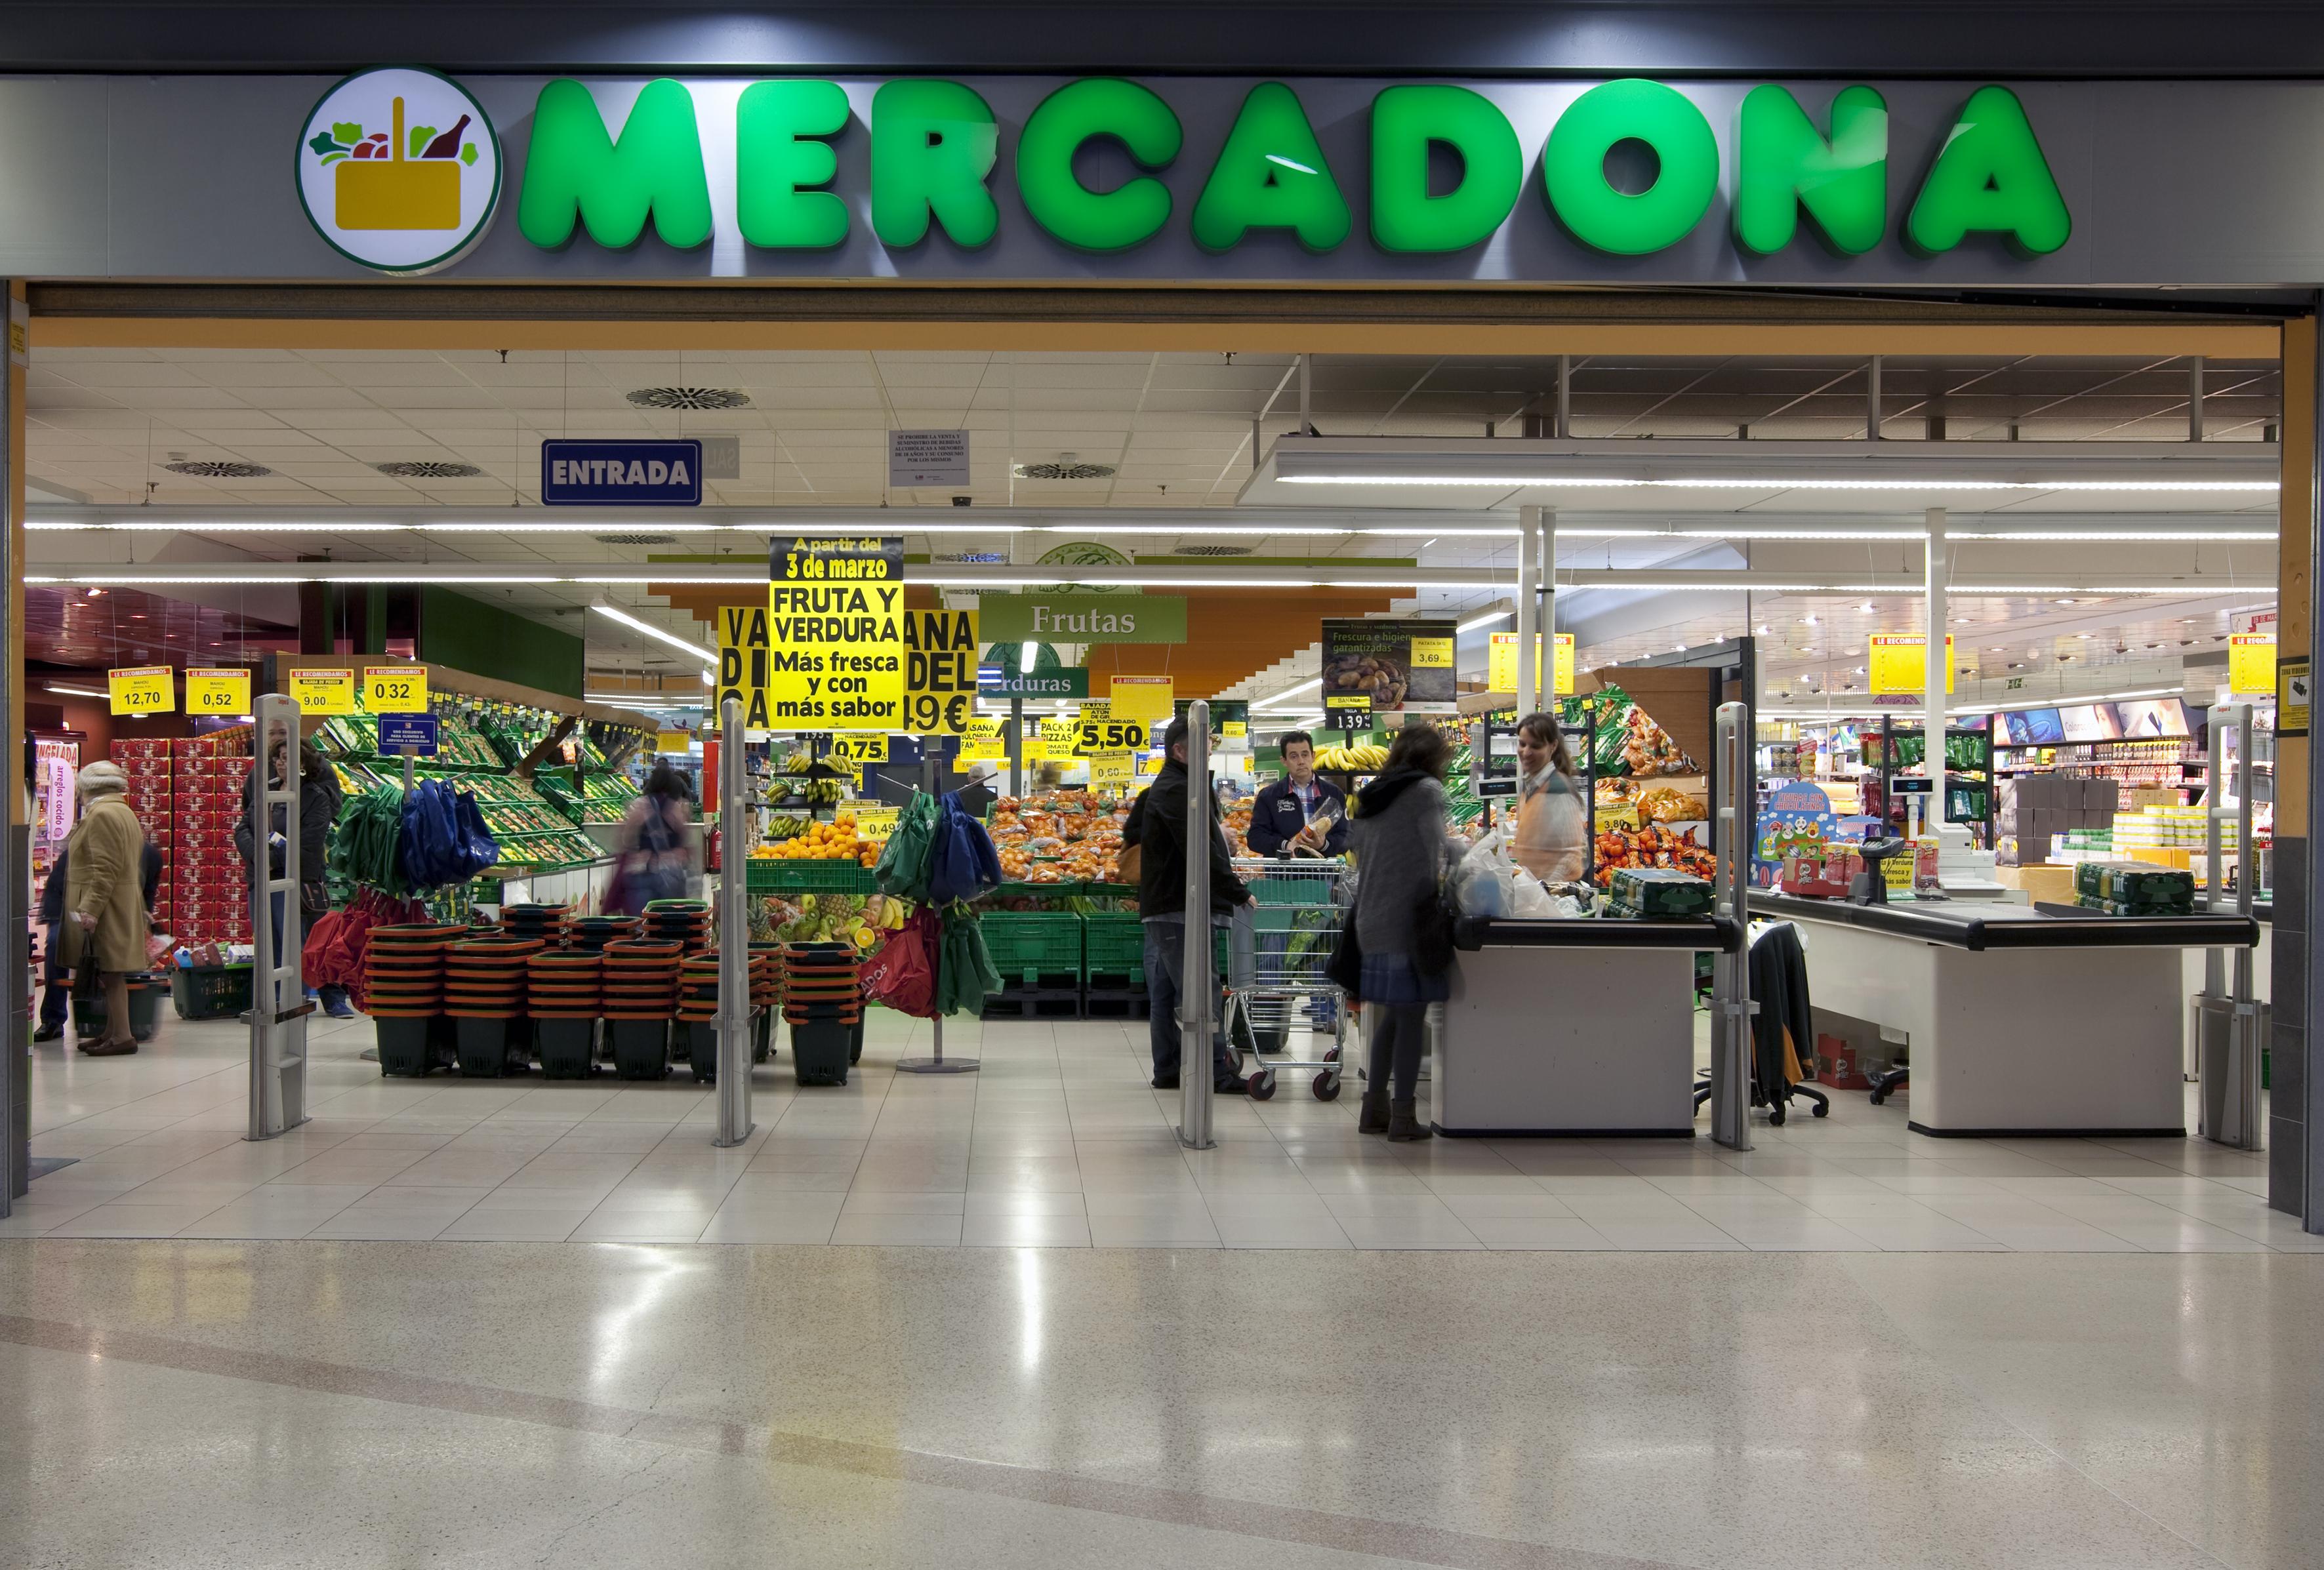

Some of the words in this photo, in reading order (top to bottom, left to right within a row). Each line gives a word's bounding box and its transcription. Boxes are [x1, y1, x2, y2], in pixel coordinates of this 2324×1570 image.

[518, 77, 2071, 254] MERCADONA
[552, 459, 691, 486] ENTRADA
[792, 538, 808, 552] A
[811, 538, 856, 554] partir
[859, 537, 882, 552] del
[786, 554, 798, 578] 3
[803, 554, 825, 578] de
[828, 559, 887, 578] marzo
[774, 588, 869, 614] FRUTA
[876, 588, 899, 613] Y
[1030, 605, 1136, 635] Frutas
[774, 617, 899, 643] VERDURA
[1333, 632, 1372, 641] Frescura
[1382, 632, 1417, 643] higiene
[1333, 644, 1392, 654] garantizadas
[774, 651, 824, 672] Más
[829, 651, 899, 672] fresca
[1419, 654, 1439, 664] 3,69
[908, 652, 977, 692] DEL
[375, 683, 409, 700] 0,32
[807, 677, 821, 695] y
[828, 676, 867, 693] con
[124, 692, 161, 706] 12,70
[203, 694, 232, 708] 0,52
[304, 696, 326, 706] 9,00
[777, 696, 825, 717] más
[830, 696, 896, 717] sabor
[1042, 723, 1066, 731] PACK
[1081, 725, 1143, 750] 5,50
[834, 741, 882, 760] 0,75
[54, 766, 65, 797] arreglos
[1097, 767, 1120, 778] 0,60
[1778, 792, 1808, 801] FIGURAS
[1809, 792, 1824, 801] CON
[56, 799, 64, 825] cocido
[1774, 801, 1825, 811] CHOCOLATINAS
[869, 822, 896, 835] 0,49
[1604, 819, 1625, 829] 3,80
